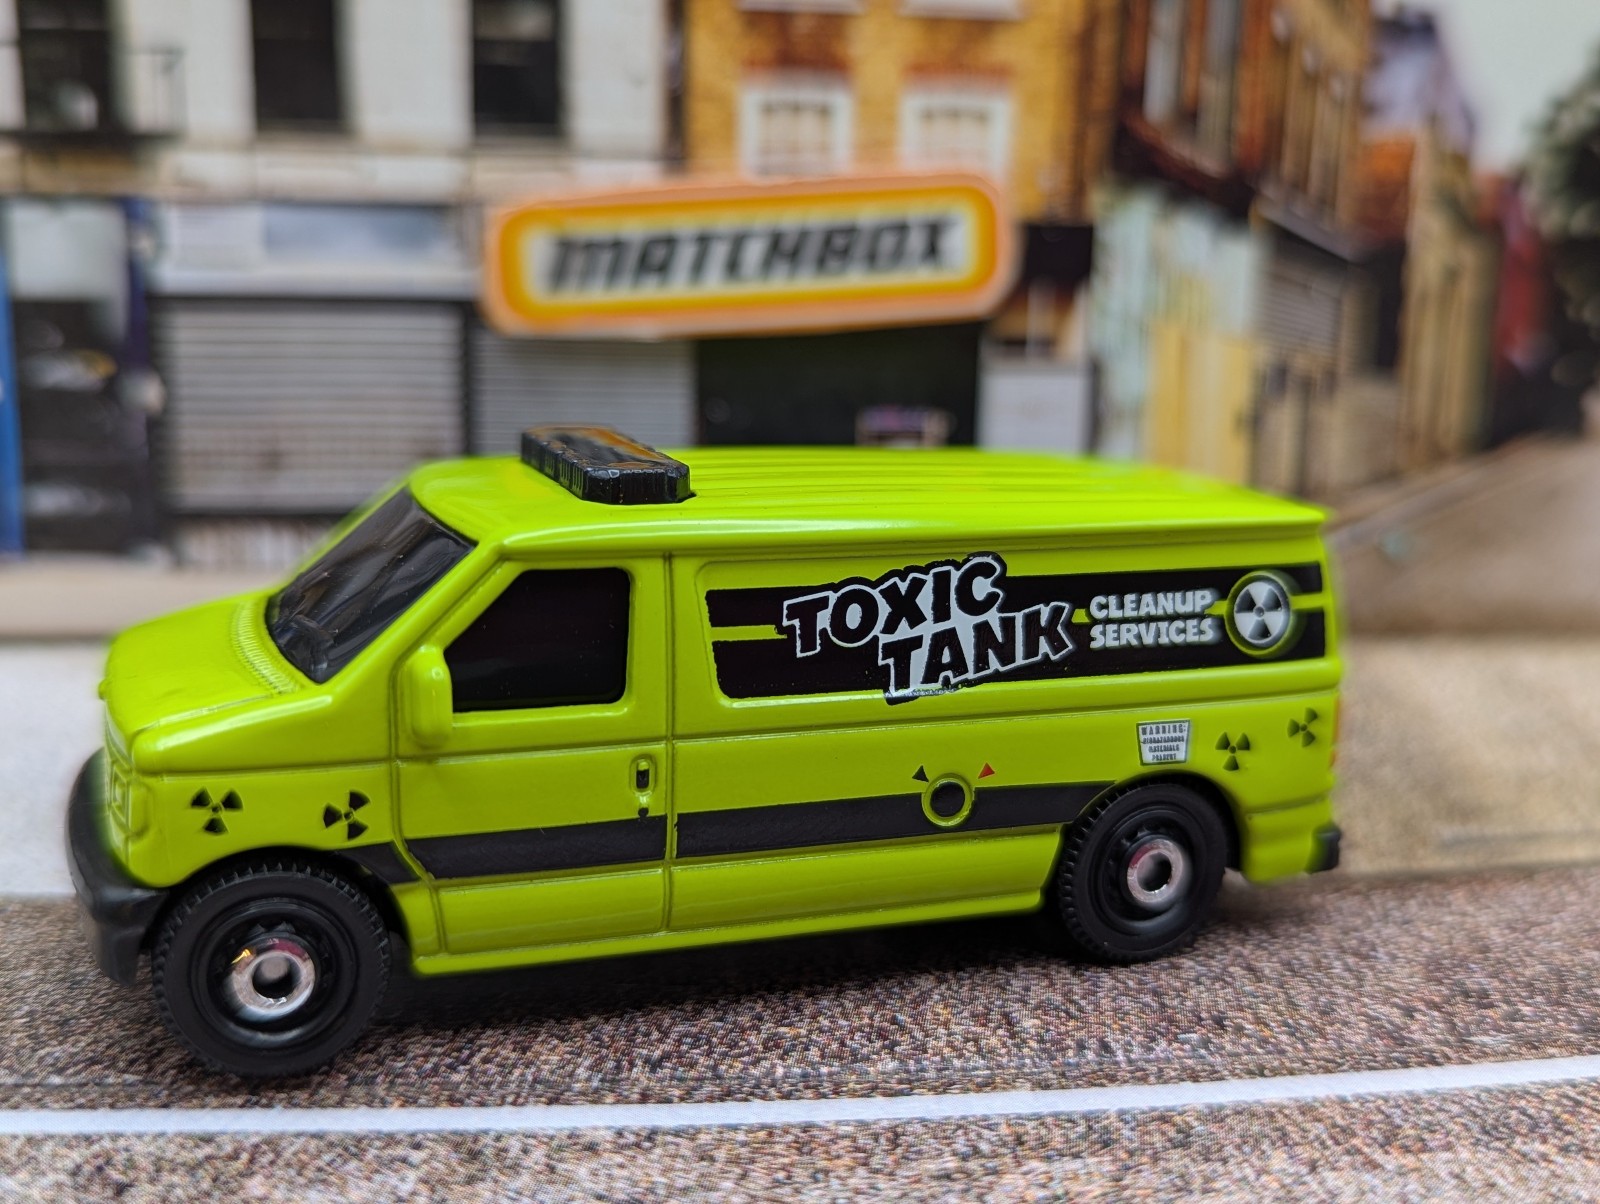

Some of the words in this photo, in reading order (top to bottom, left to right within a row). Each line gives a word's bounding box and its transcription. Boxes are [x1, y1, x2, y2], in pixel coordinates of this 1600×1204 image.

[549, 215, 957, 291] MATCHBOX
[783, 556, 1002, 657] TOXIC
[1089, 616, 1214, 649] SERVICES
[1090, 589, 1214, 619] CLEANUP
[878, 601, 1074, 696] TANK
